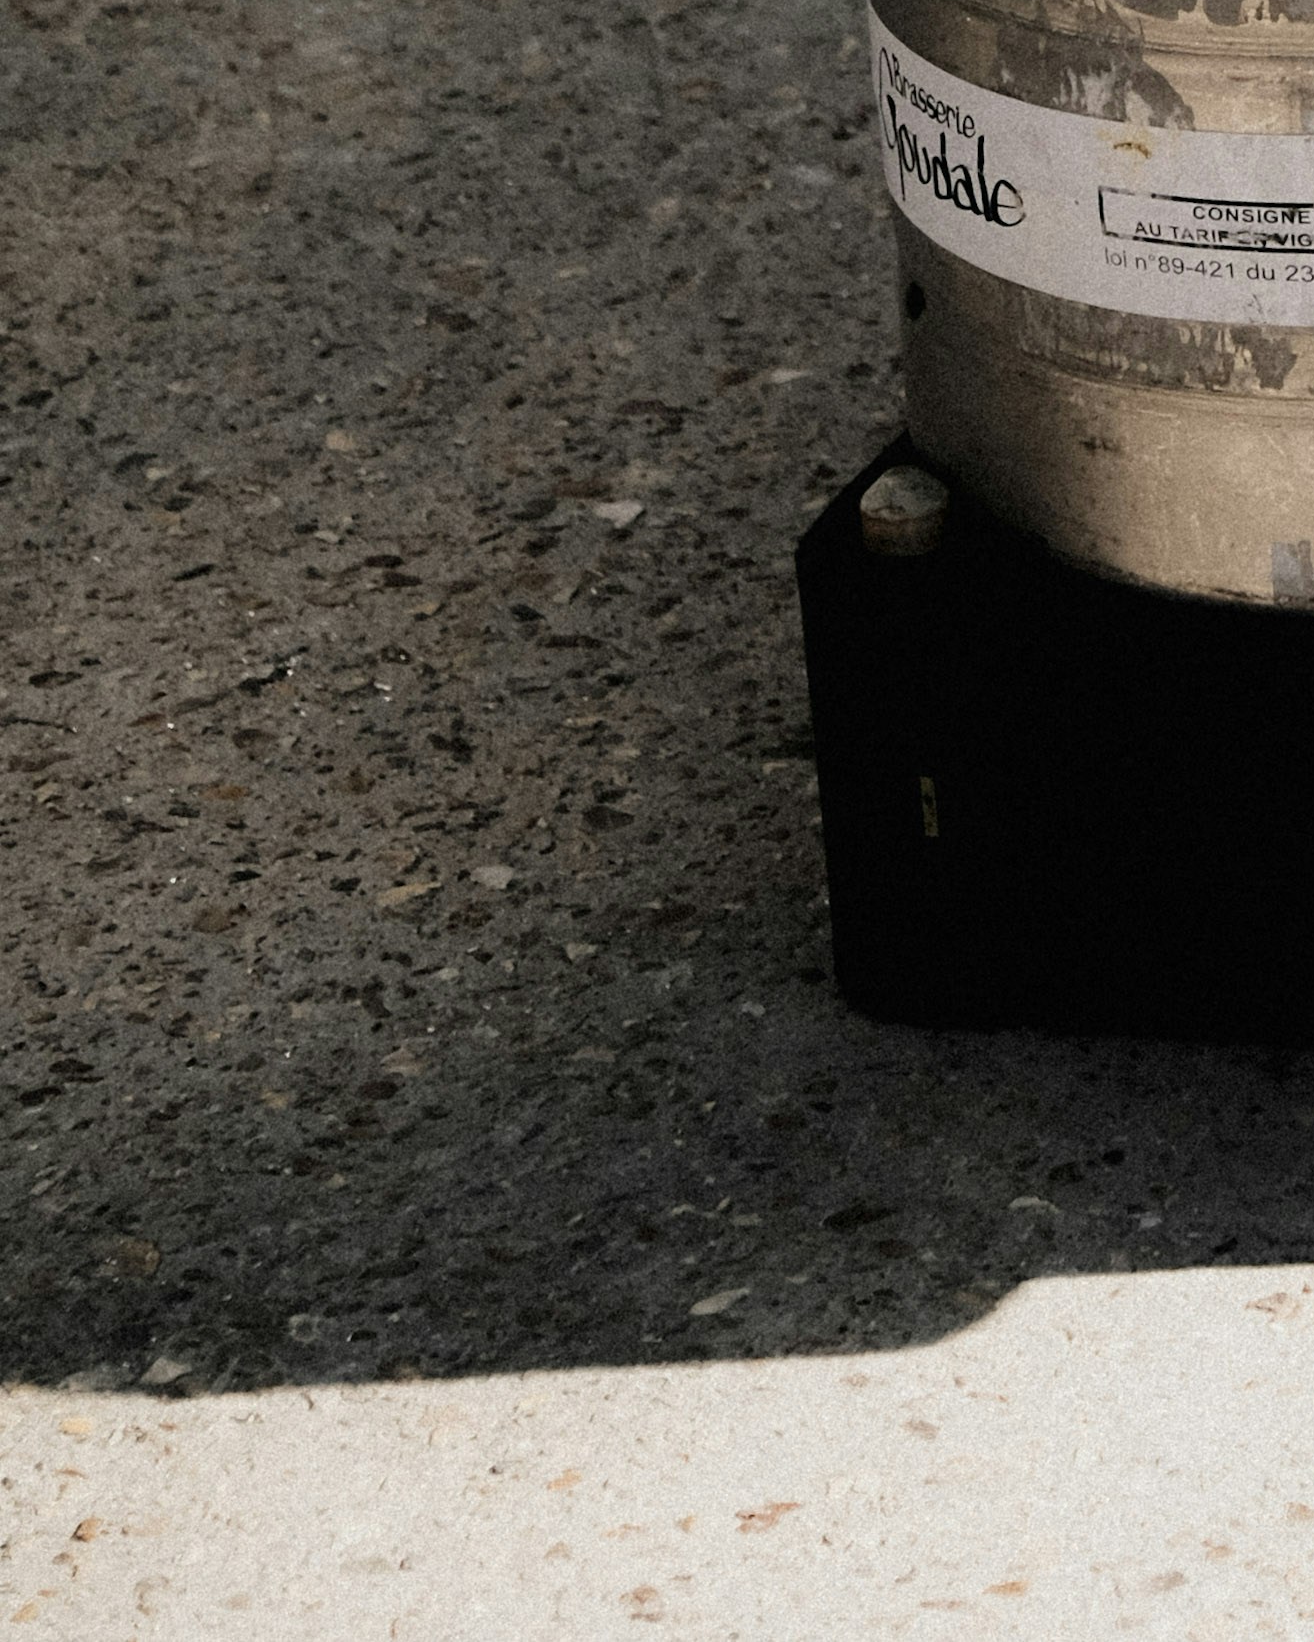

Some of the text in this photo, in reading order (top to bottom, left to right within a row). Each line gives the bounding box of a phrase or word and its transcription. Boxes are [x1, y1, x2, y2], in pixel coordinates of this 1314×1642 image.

[891, 53, 976, 139] Brasserie
[879, 46, 1027, 228] Goudale
[1135, 221, 1162, 237] AU
[1169, 225, 1229, 244] TARIF
[1192, 205, 1312, 225] CONSIGNE
[1105, 247, 1128, 268] loi
[1246, 262, 1275, 282] du
